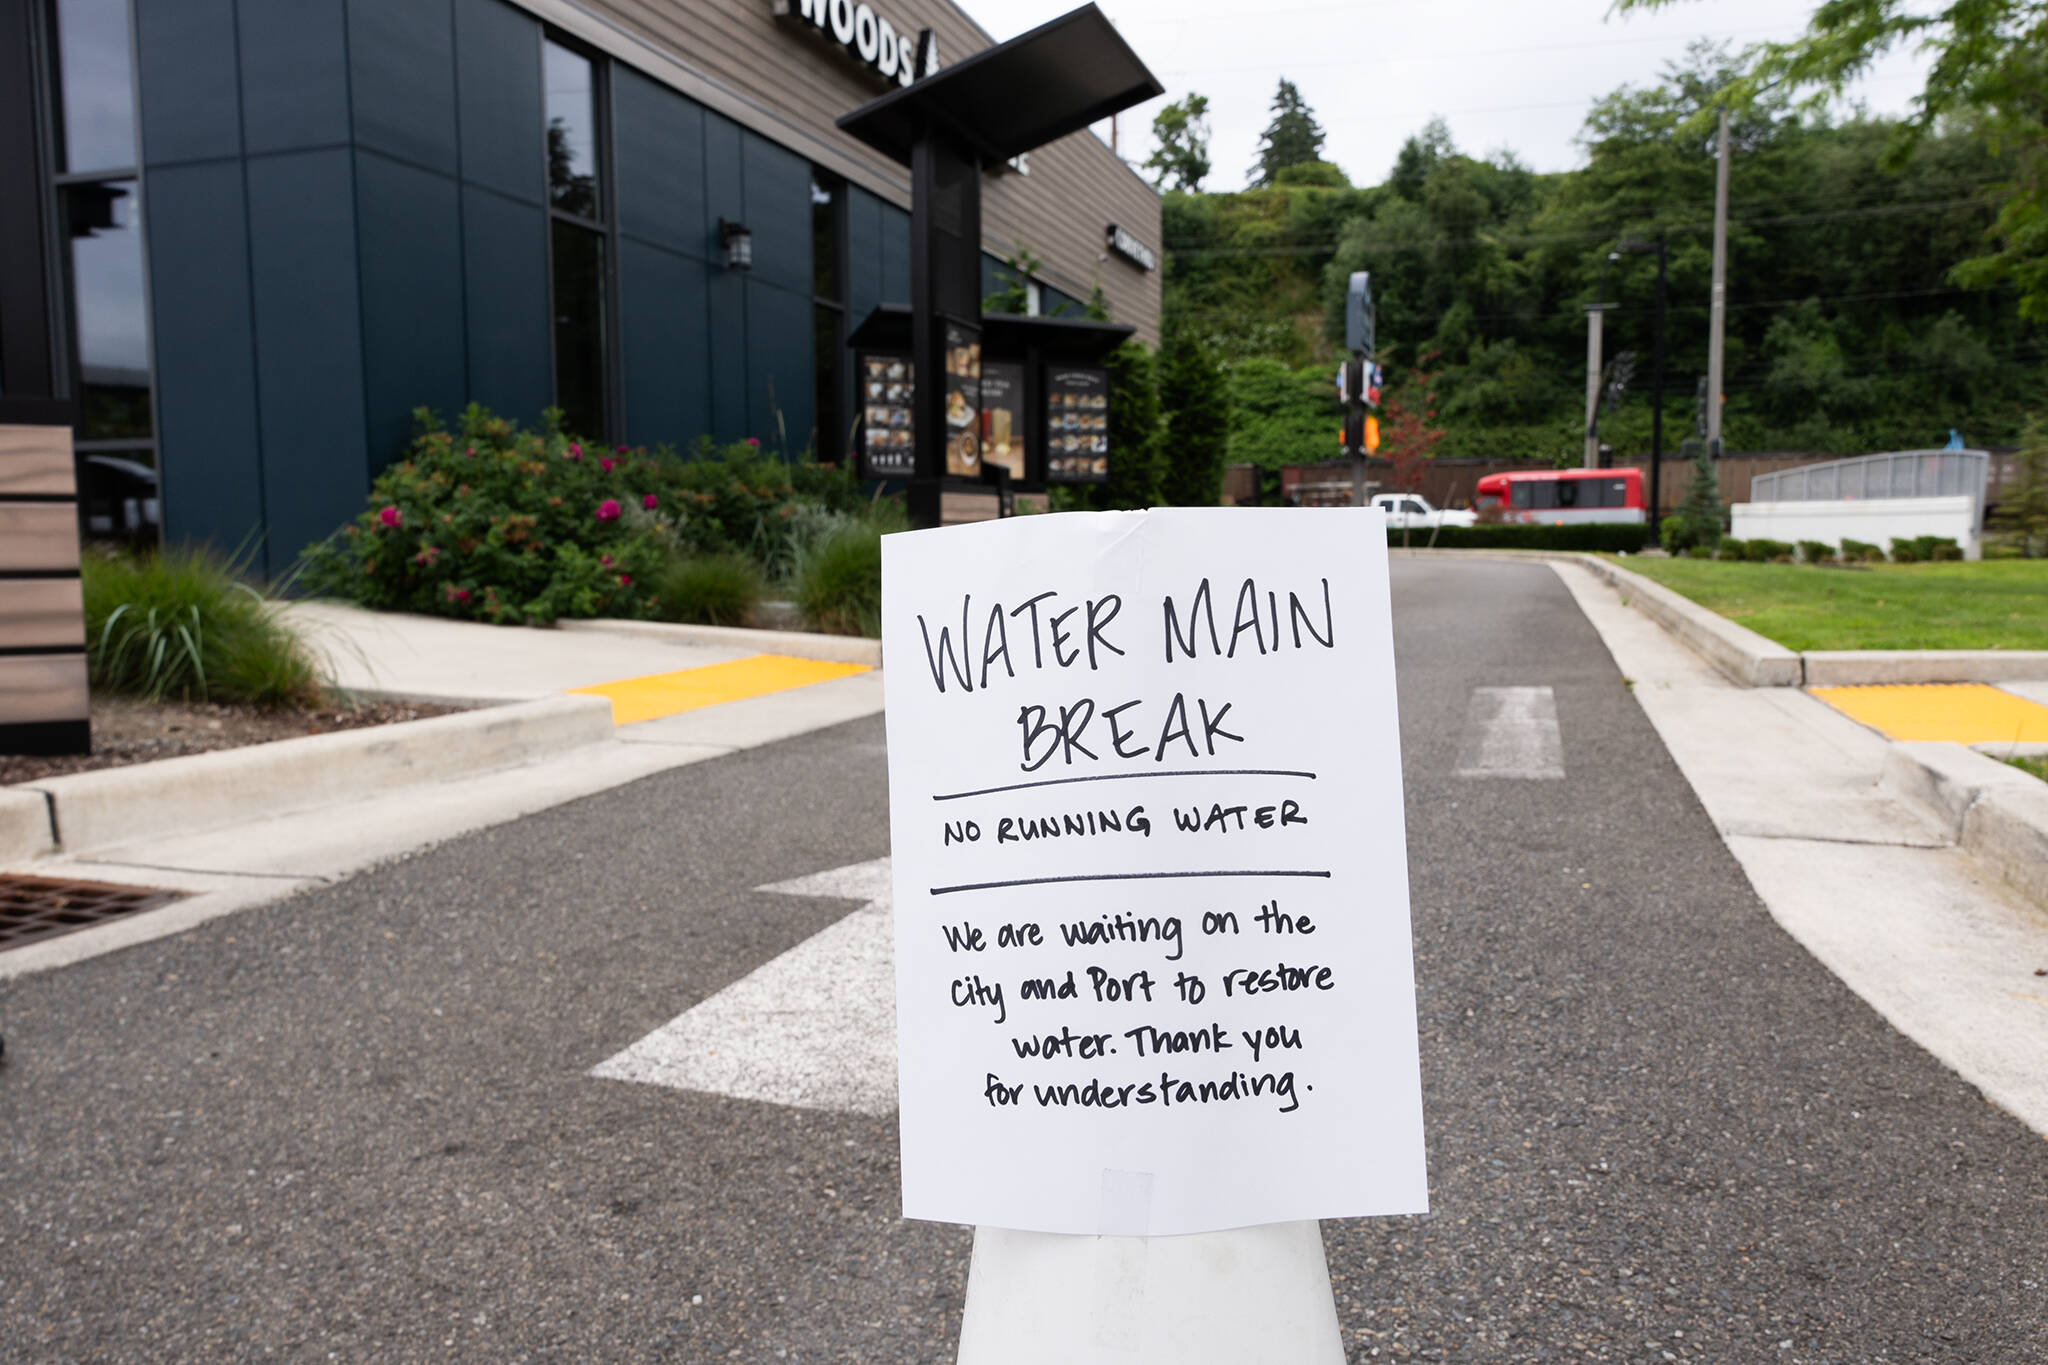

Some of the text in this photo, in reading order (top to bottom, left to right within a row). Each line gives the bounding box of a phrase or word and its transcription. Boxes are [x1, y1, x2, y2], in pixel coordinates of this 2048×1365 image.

[917, 578, 1334, 693] WATER MAIN
[1017, 693, 1244, 772] BREAK
[945, 799, 1308, 846] NO RUNNING WATER
[942, 900, 1316, 960] We are waiting on the
[1021, 971, 1077, 1000] and
[1086, 966, 1156, 1002] Port
[1173, 971, 1206, 1005] to
[1223, 962, 1335, 998] restore
[1011, 1023, 1303, 1062] water. Thank you
[984, 1071, 1313, 1113] for understanding.
